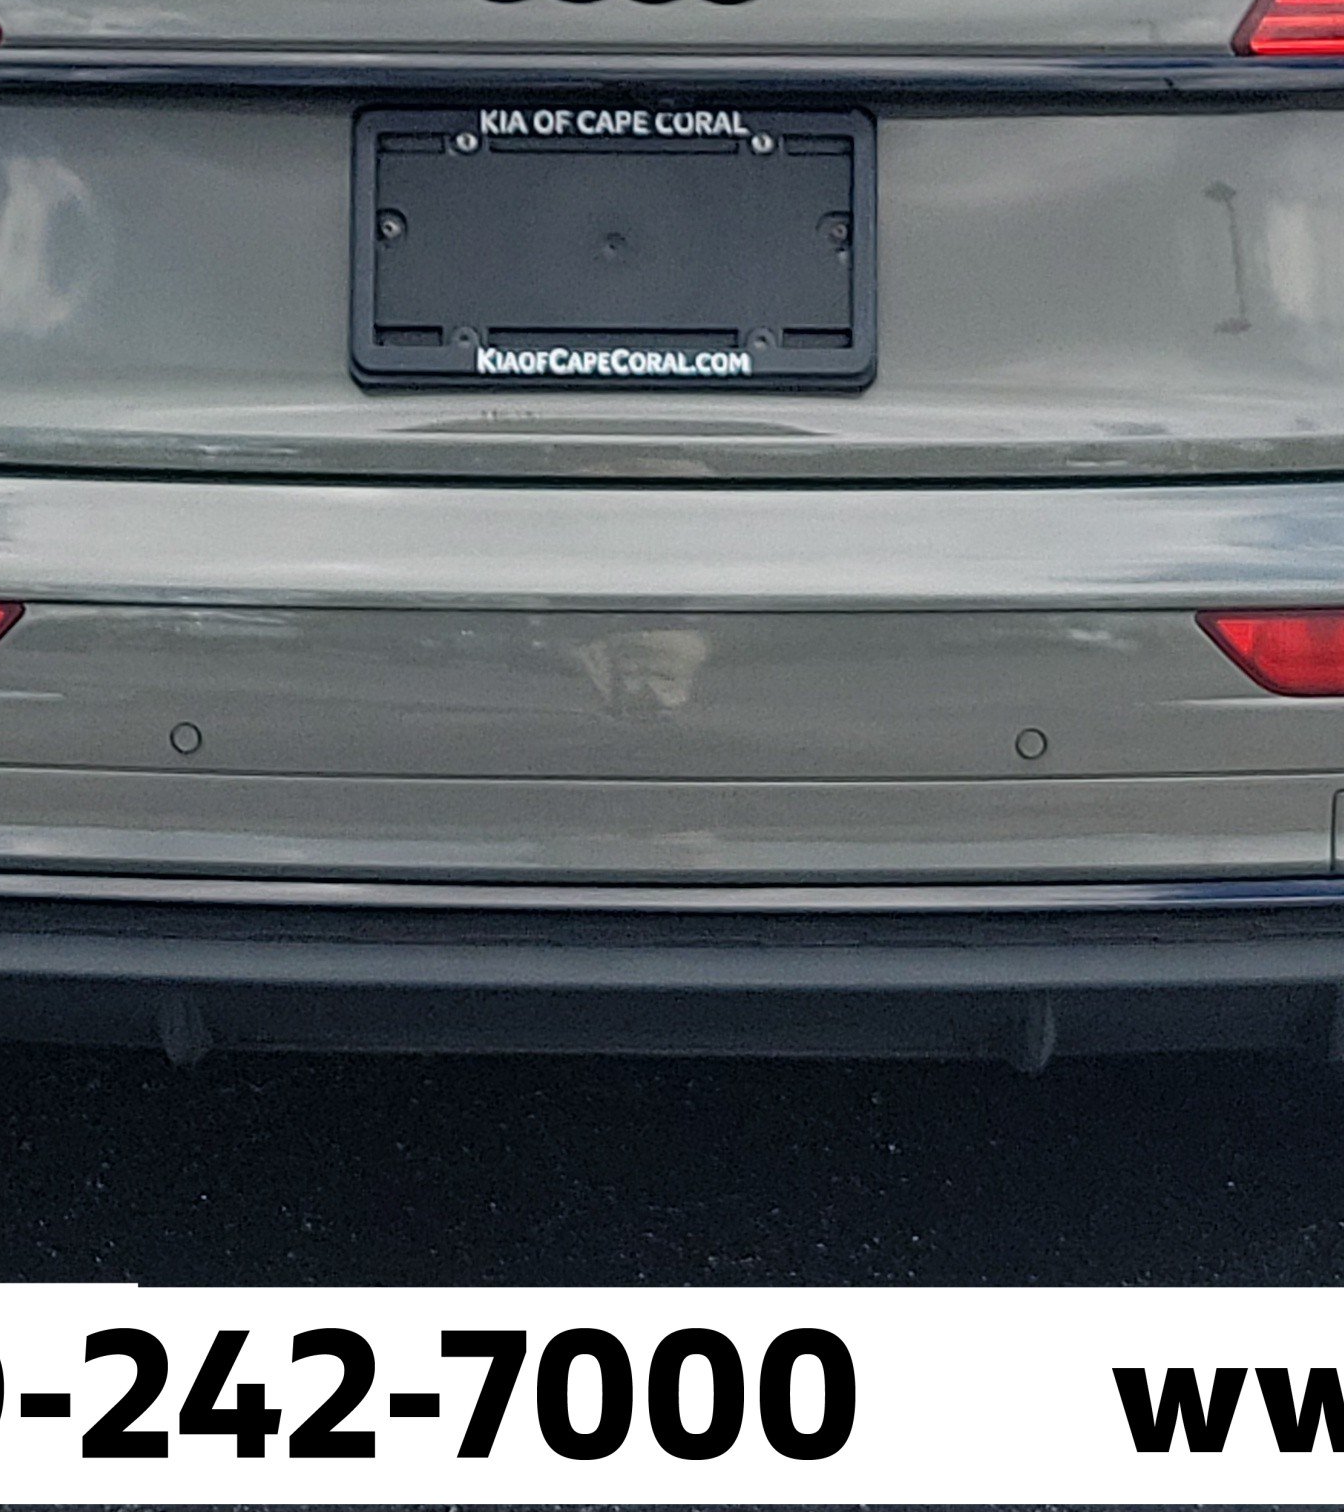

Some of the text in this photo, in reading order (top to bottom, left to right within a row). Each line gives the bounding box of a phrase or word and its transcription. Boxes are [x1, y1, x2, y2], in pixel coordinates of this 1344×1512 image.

[480, 109, 749, 134] KIA OF CAPE CORAL
